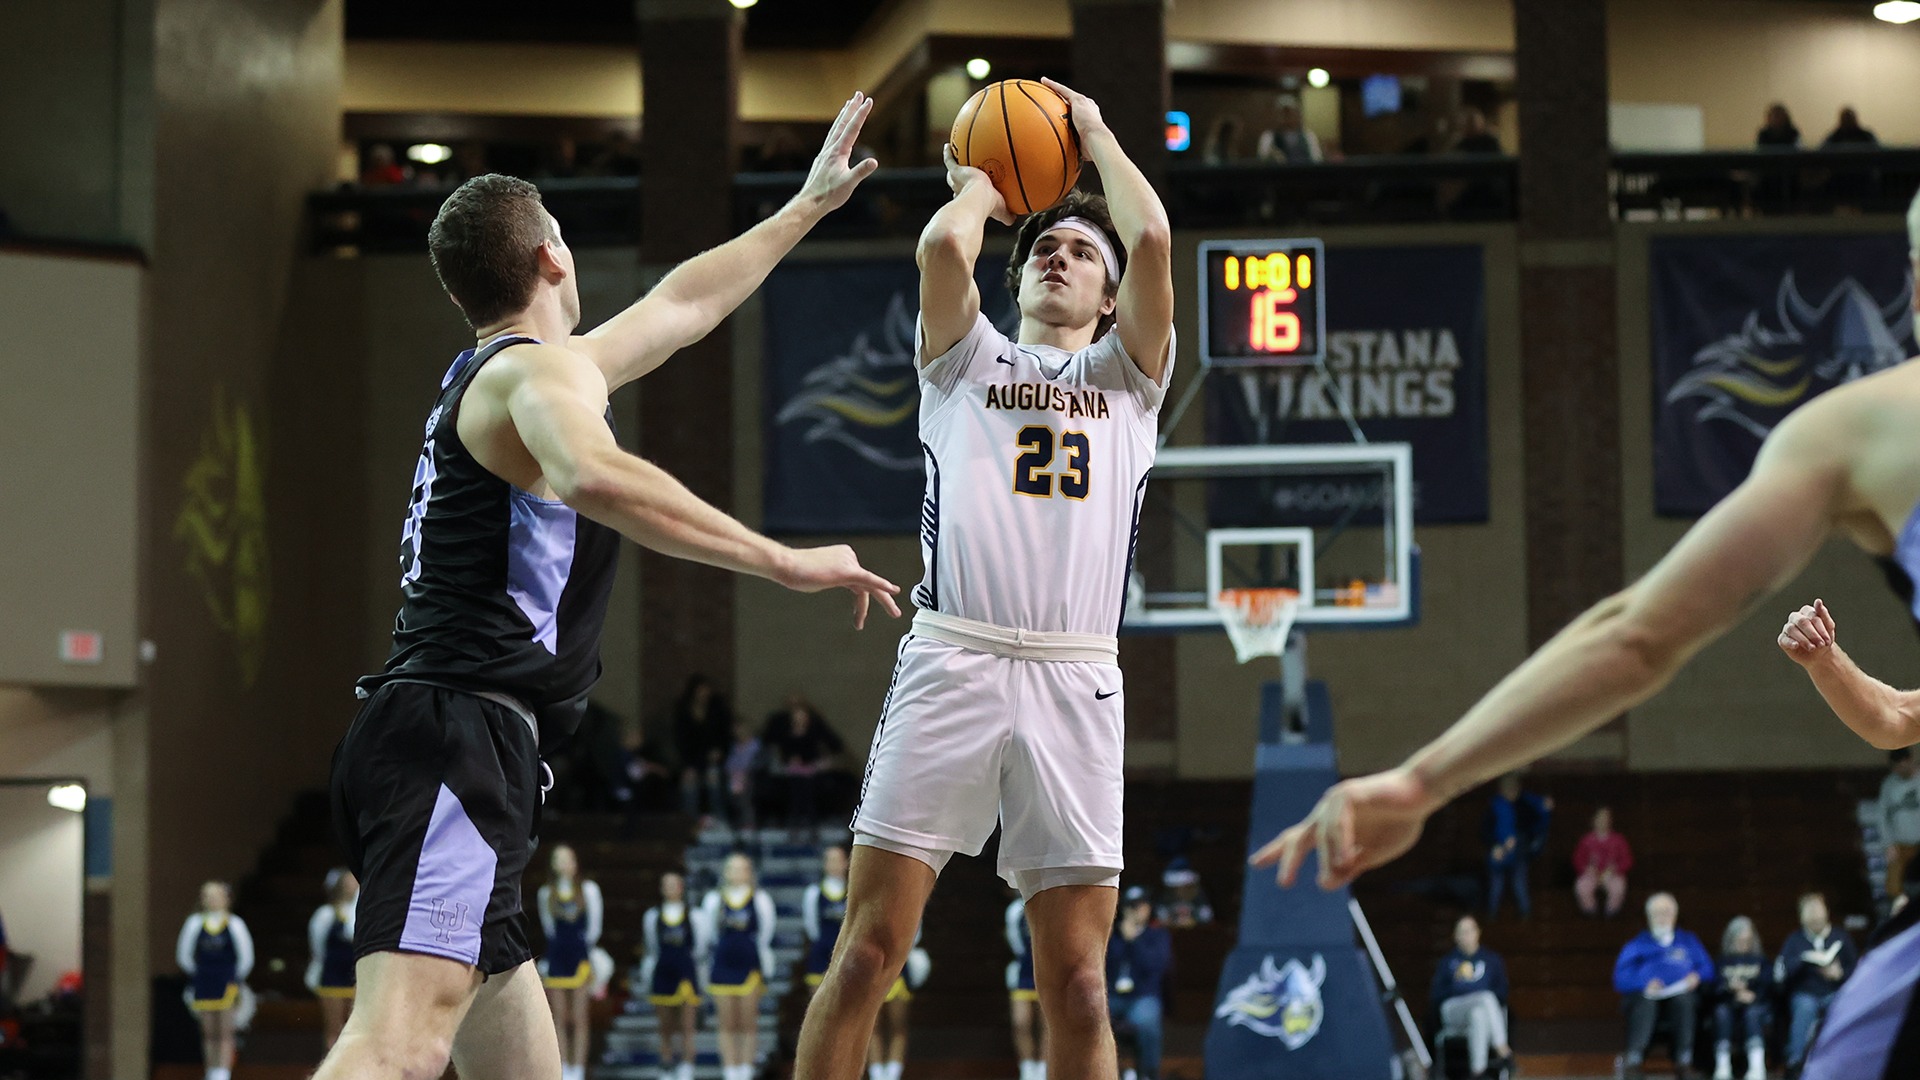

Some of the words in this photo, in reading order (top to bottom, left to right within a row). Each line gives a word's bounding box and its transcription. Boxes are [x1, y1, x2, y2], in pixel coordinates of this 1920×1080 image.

[1225, 253, 1311, 291] 11:01
[1250, 287, 1300, 351] 16
[1012, 424, 1090, 502] 23
